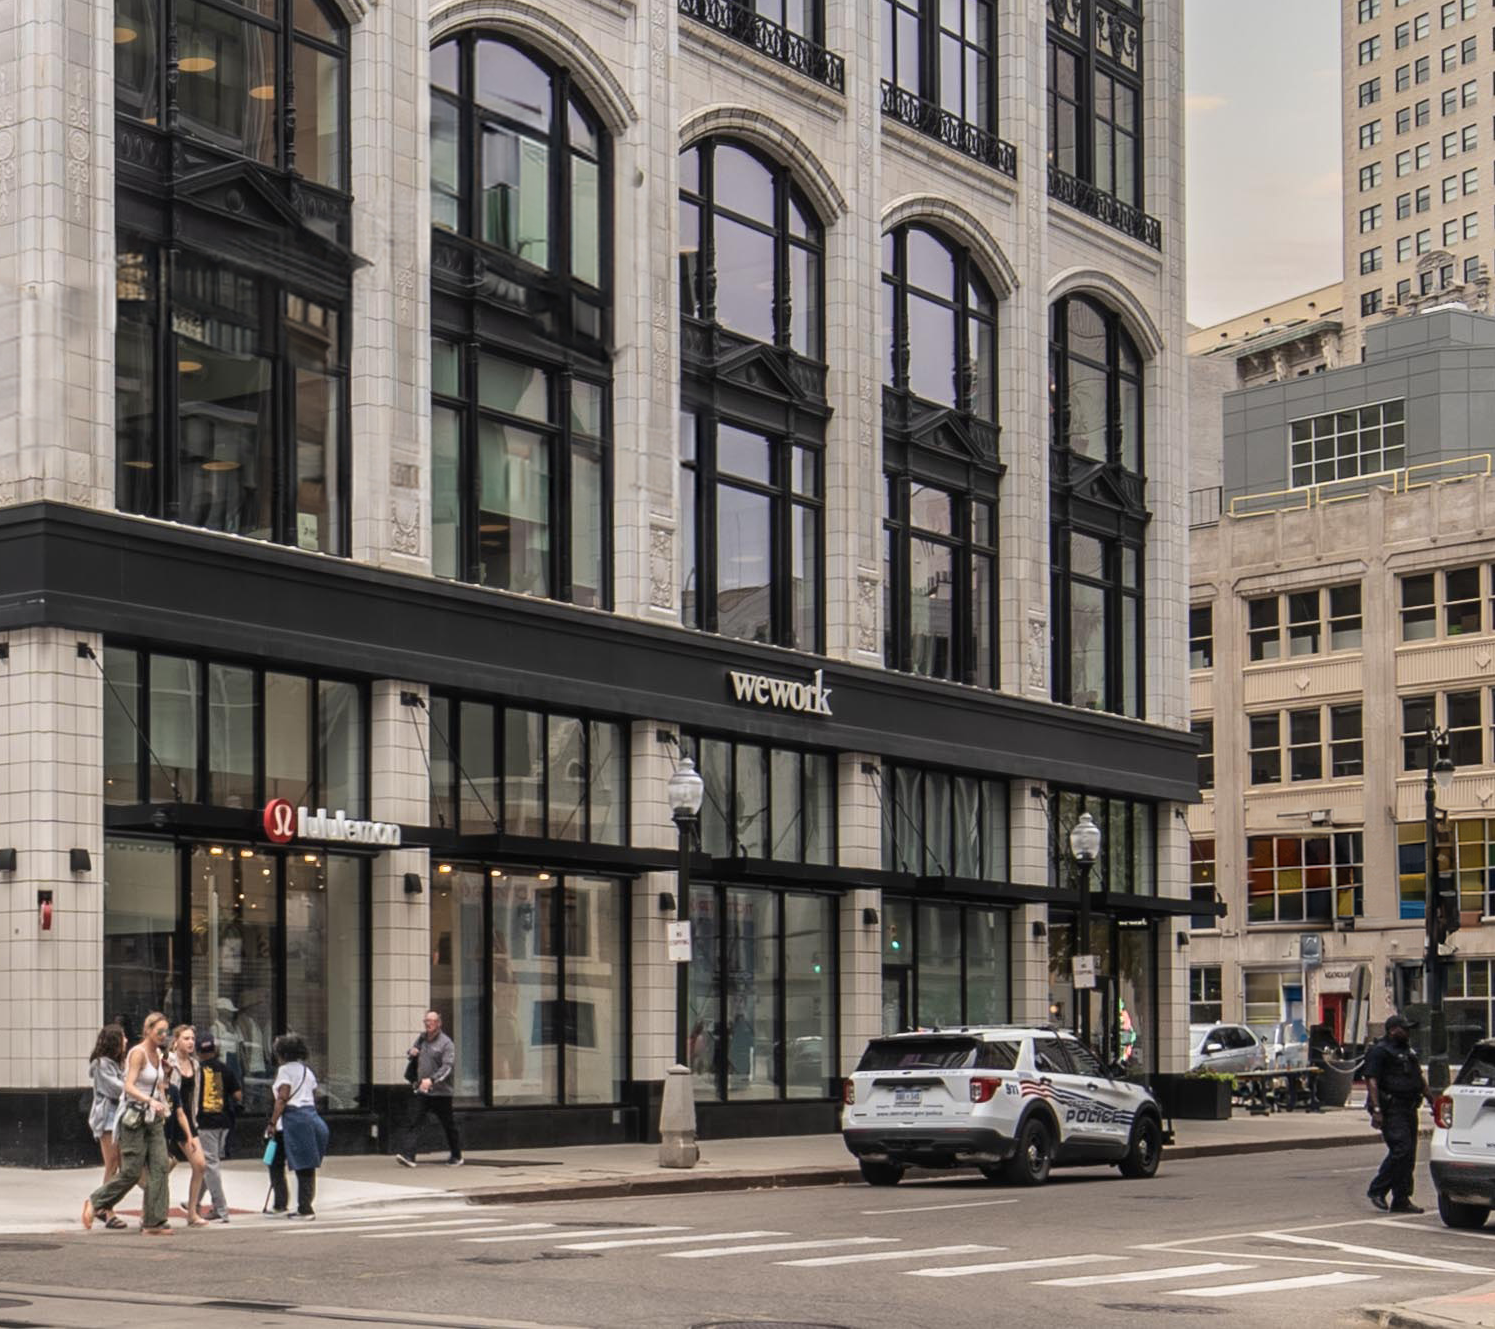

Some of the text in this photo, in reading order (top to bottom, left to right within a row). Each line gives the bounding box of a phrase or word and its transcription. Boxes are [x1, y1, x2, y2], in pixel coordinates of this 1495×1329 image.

[730, 669, 833, 716] wework
[297, 806, 401, 846] lululemon
[1066, 1109, 1122, 1123] POLICE
